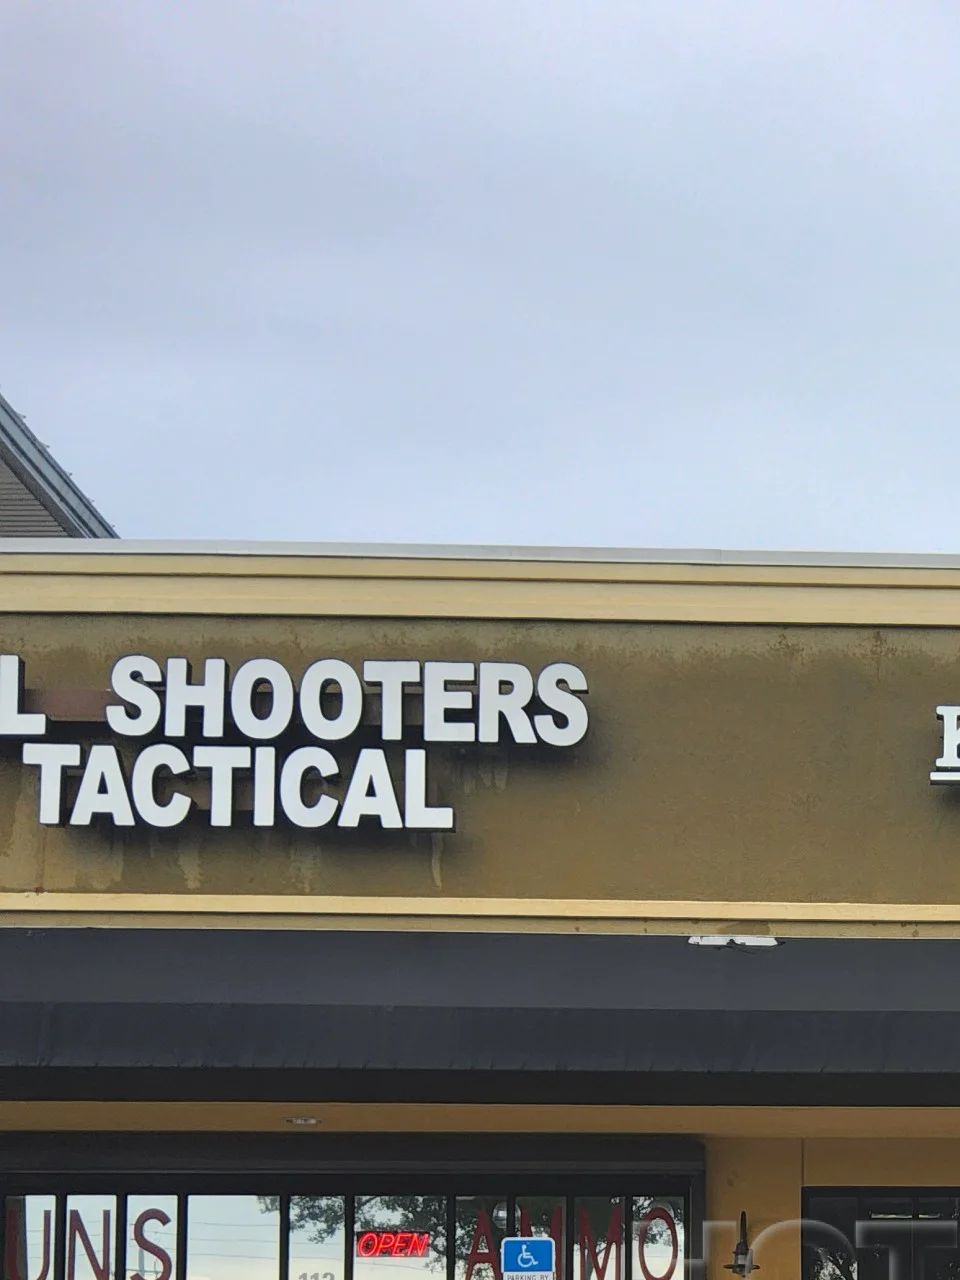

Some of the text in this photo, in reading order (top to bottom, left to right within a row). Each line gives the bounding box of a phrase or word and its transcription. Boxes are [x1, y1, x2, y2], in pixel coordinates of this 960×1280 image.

[105, 654, 590, 747] SHOOTERS
[22, 743, 454, 829] TACTICAL
[358, 1232, 429, 1257] OPEN
